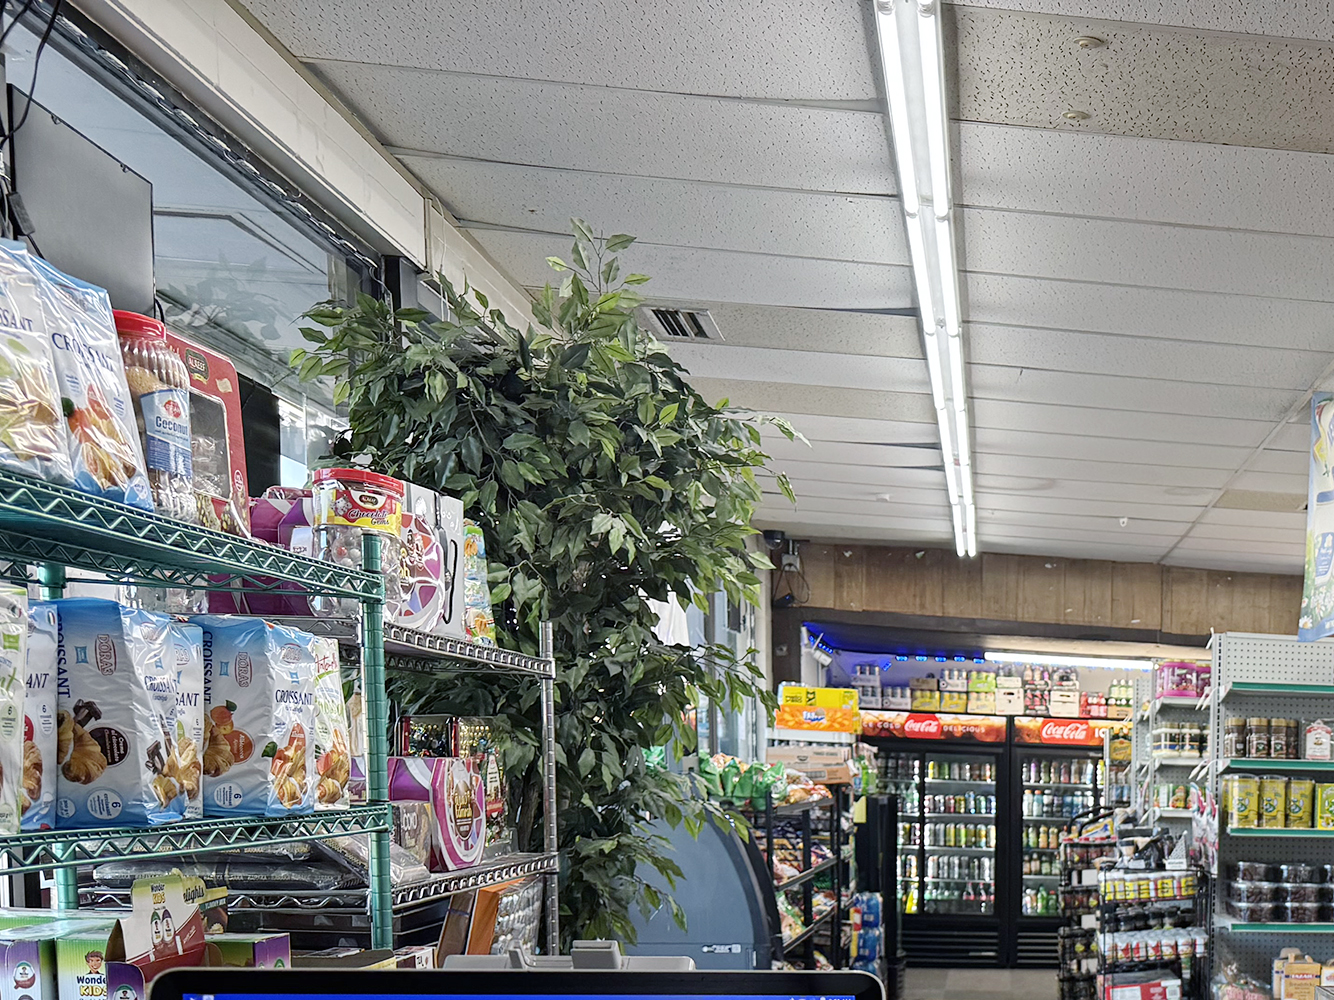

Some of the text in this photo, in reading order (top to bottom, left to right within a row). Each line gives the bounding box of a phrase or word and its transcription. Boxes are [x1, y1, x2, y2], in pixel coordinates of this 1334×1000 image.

[155, 416, 189, 436] Coconut
[348, 509, 389, 520] Chocolate
[370, 516, 390, 526] Gems
[203, 631, 213, 704] CROISSANT
[275, 689, 314, 706] CROISSANT
[943, 725, 986, 733] DELICIOUS
[1042, 723, 1088, 740] Coca-Cola
